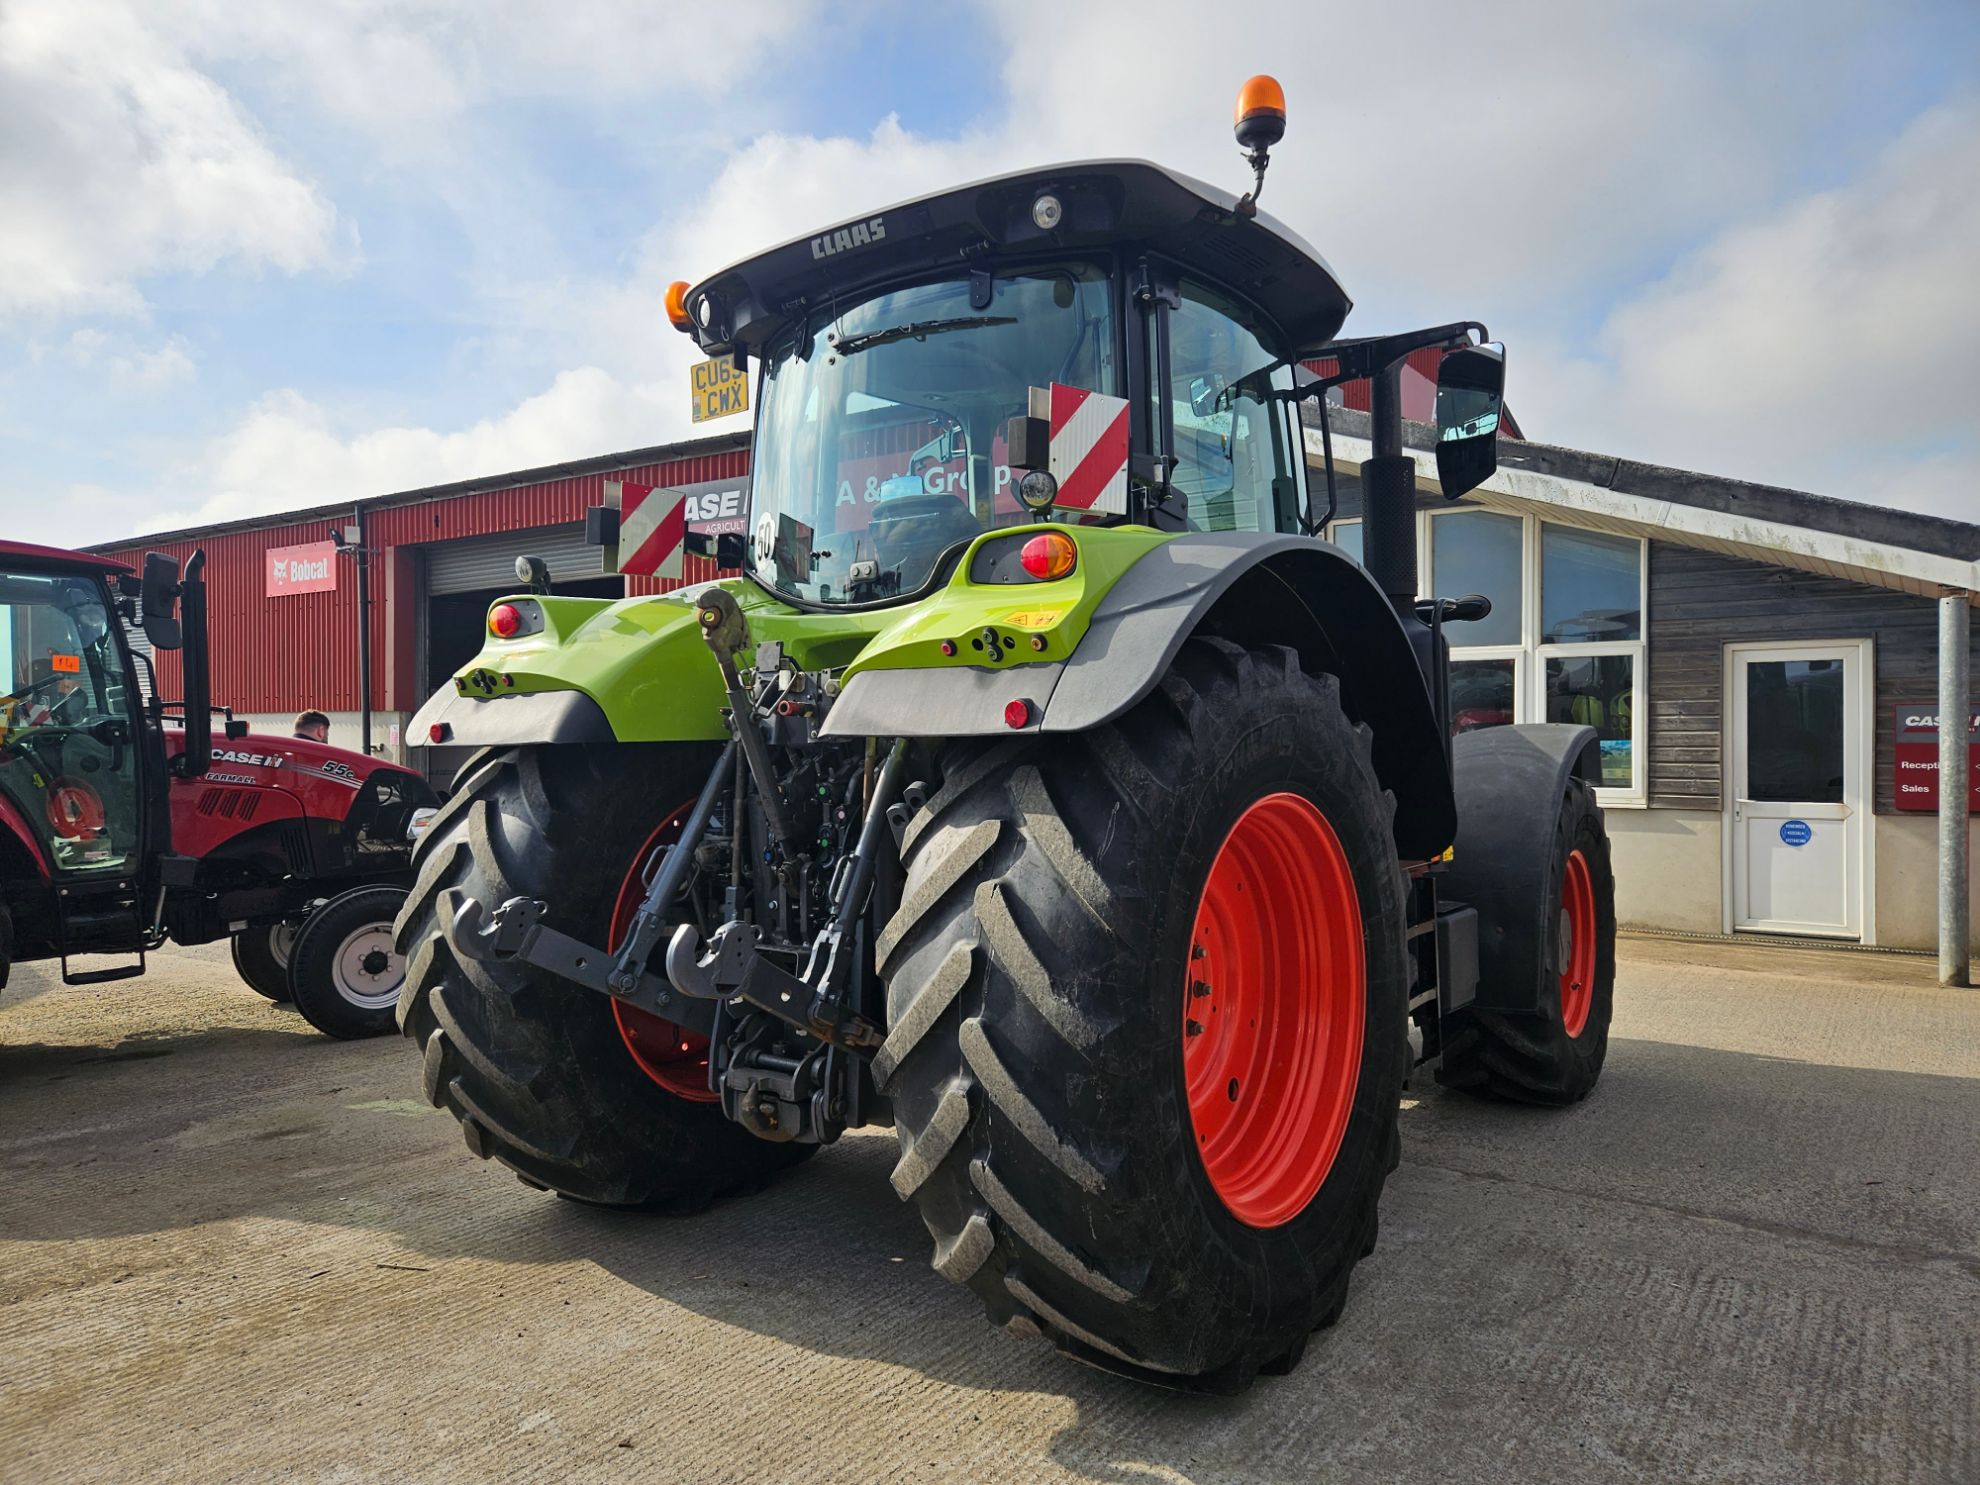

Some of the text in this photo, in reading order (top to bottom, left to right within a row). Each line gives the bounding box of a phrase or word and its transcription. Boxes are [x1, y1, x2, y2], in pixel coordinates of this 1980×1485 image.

[811, 217, 886, 260] CLAAS
[707, 384, 742, 416] CWX
[835, 479, 857, 507] A
[863, 475, 881, 504] &
[684, 490, 740, 521] ASE
[705, 520, 745, 534] AGRICULT
[757, 521, 771, 561] 50
[290, 558, 328, 582] Bobcat
[1905, 715, 1940, 727] CAS
[211, 749, 263, 766] CASE
[205, 772, 257, 785] FARMALL
[1901, 784, 1930, 793] Sales
